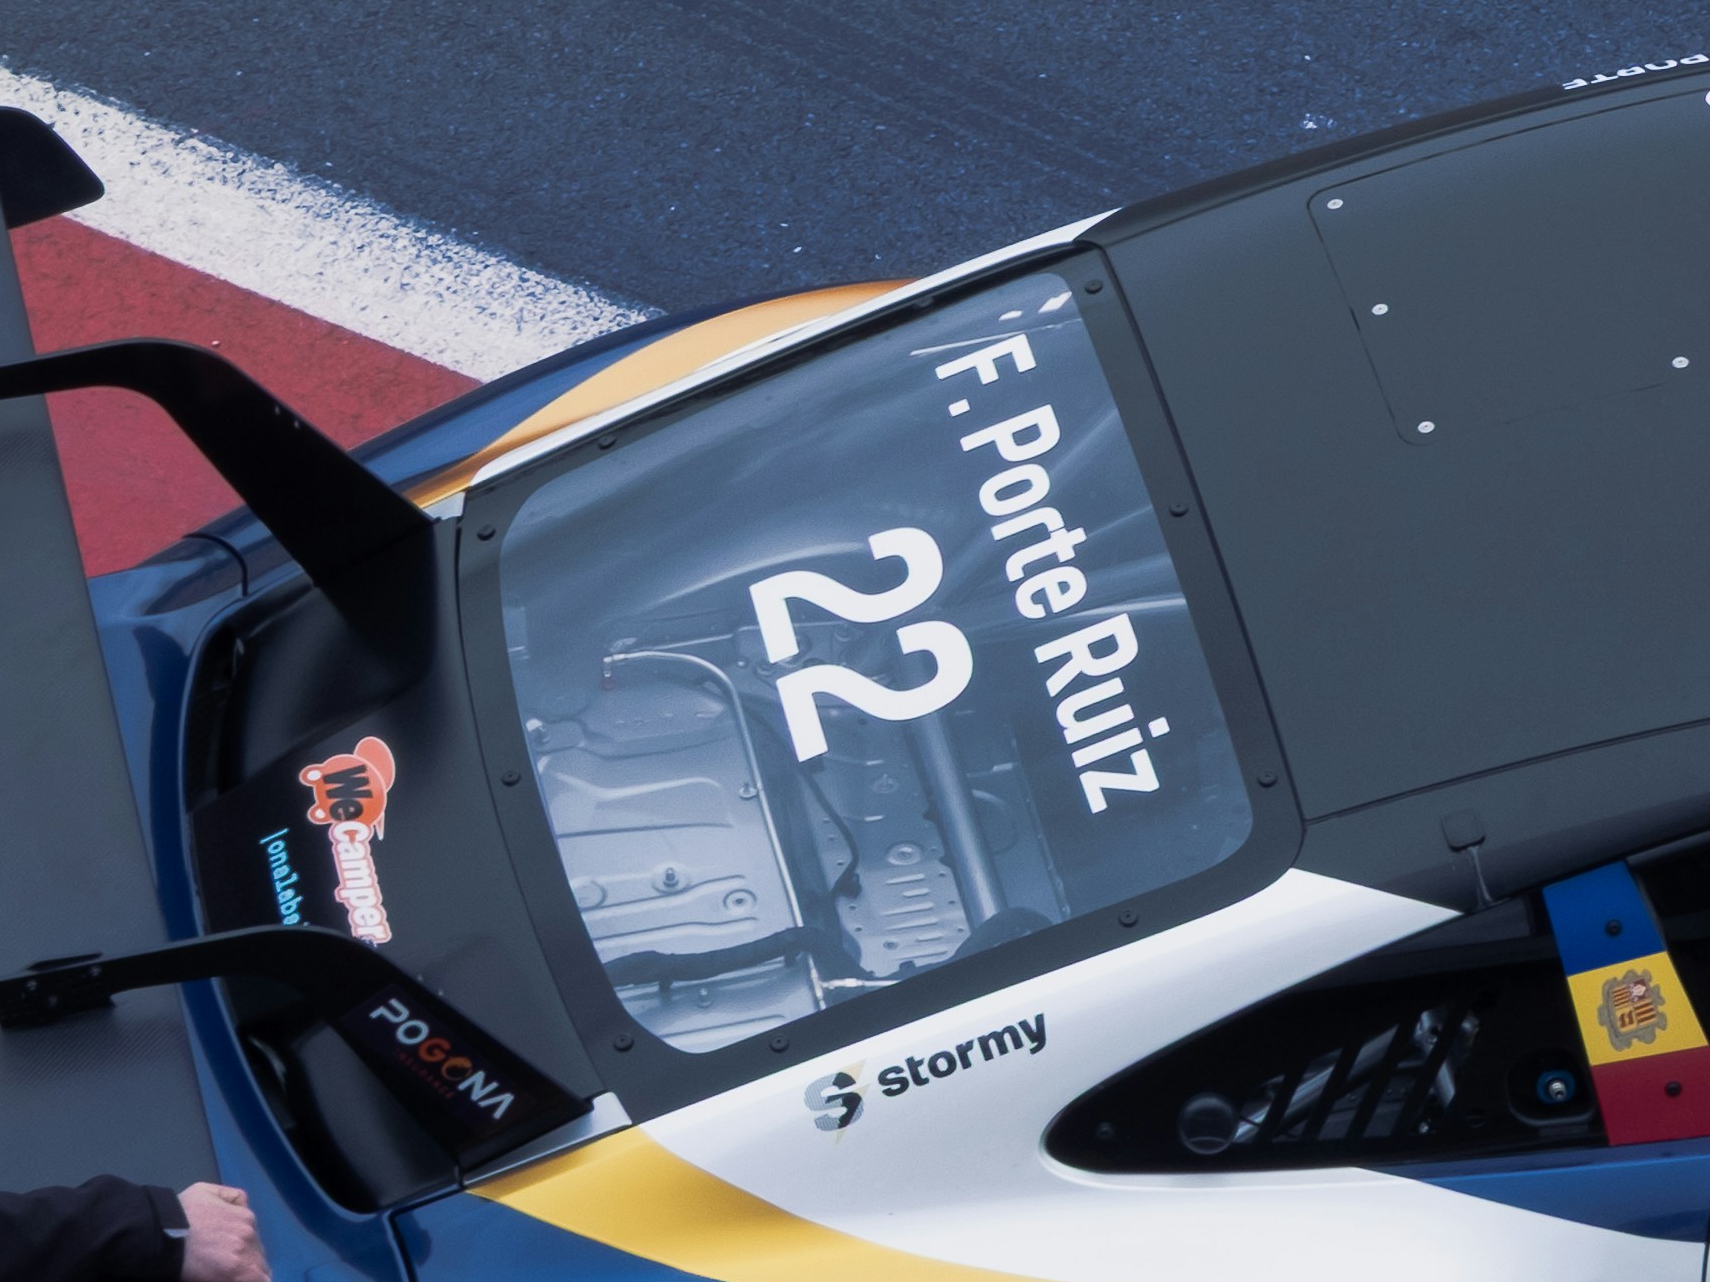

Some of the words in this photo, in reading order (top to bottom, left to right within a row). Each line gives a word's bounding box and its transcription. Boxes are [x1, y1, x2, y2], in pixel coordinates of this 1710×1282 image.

[749, 526, 975, 763] 22
[960, 404, 1089, 620] Porte
[1035, 612, 1171, 815] Ruiz
[369, 998, 516, 1120] POGONA
